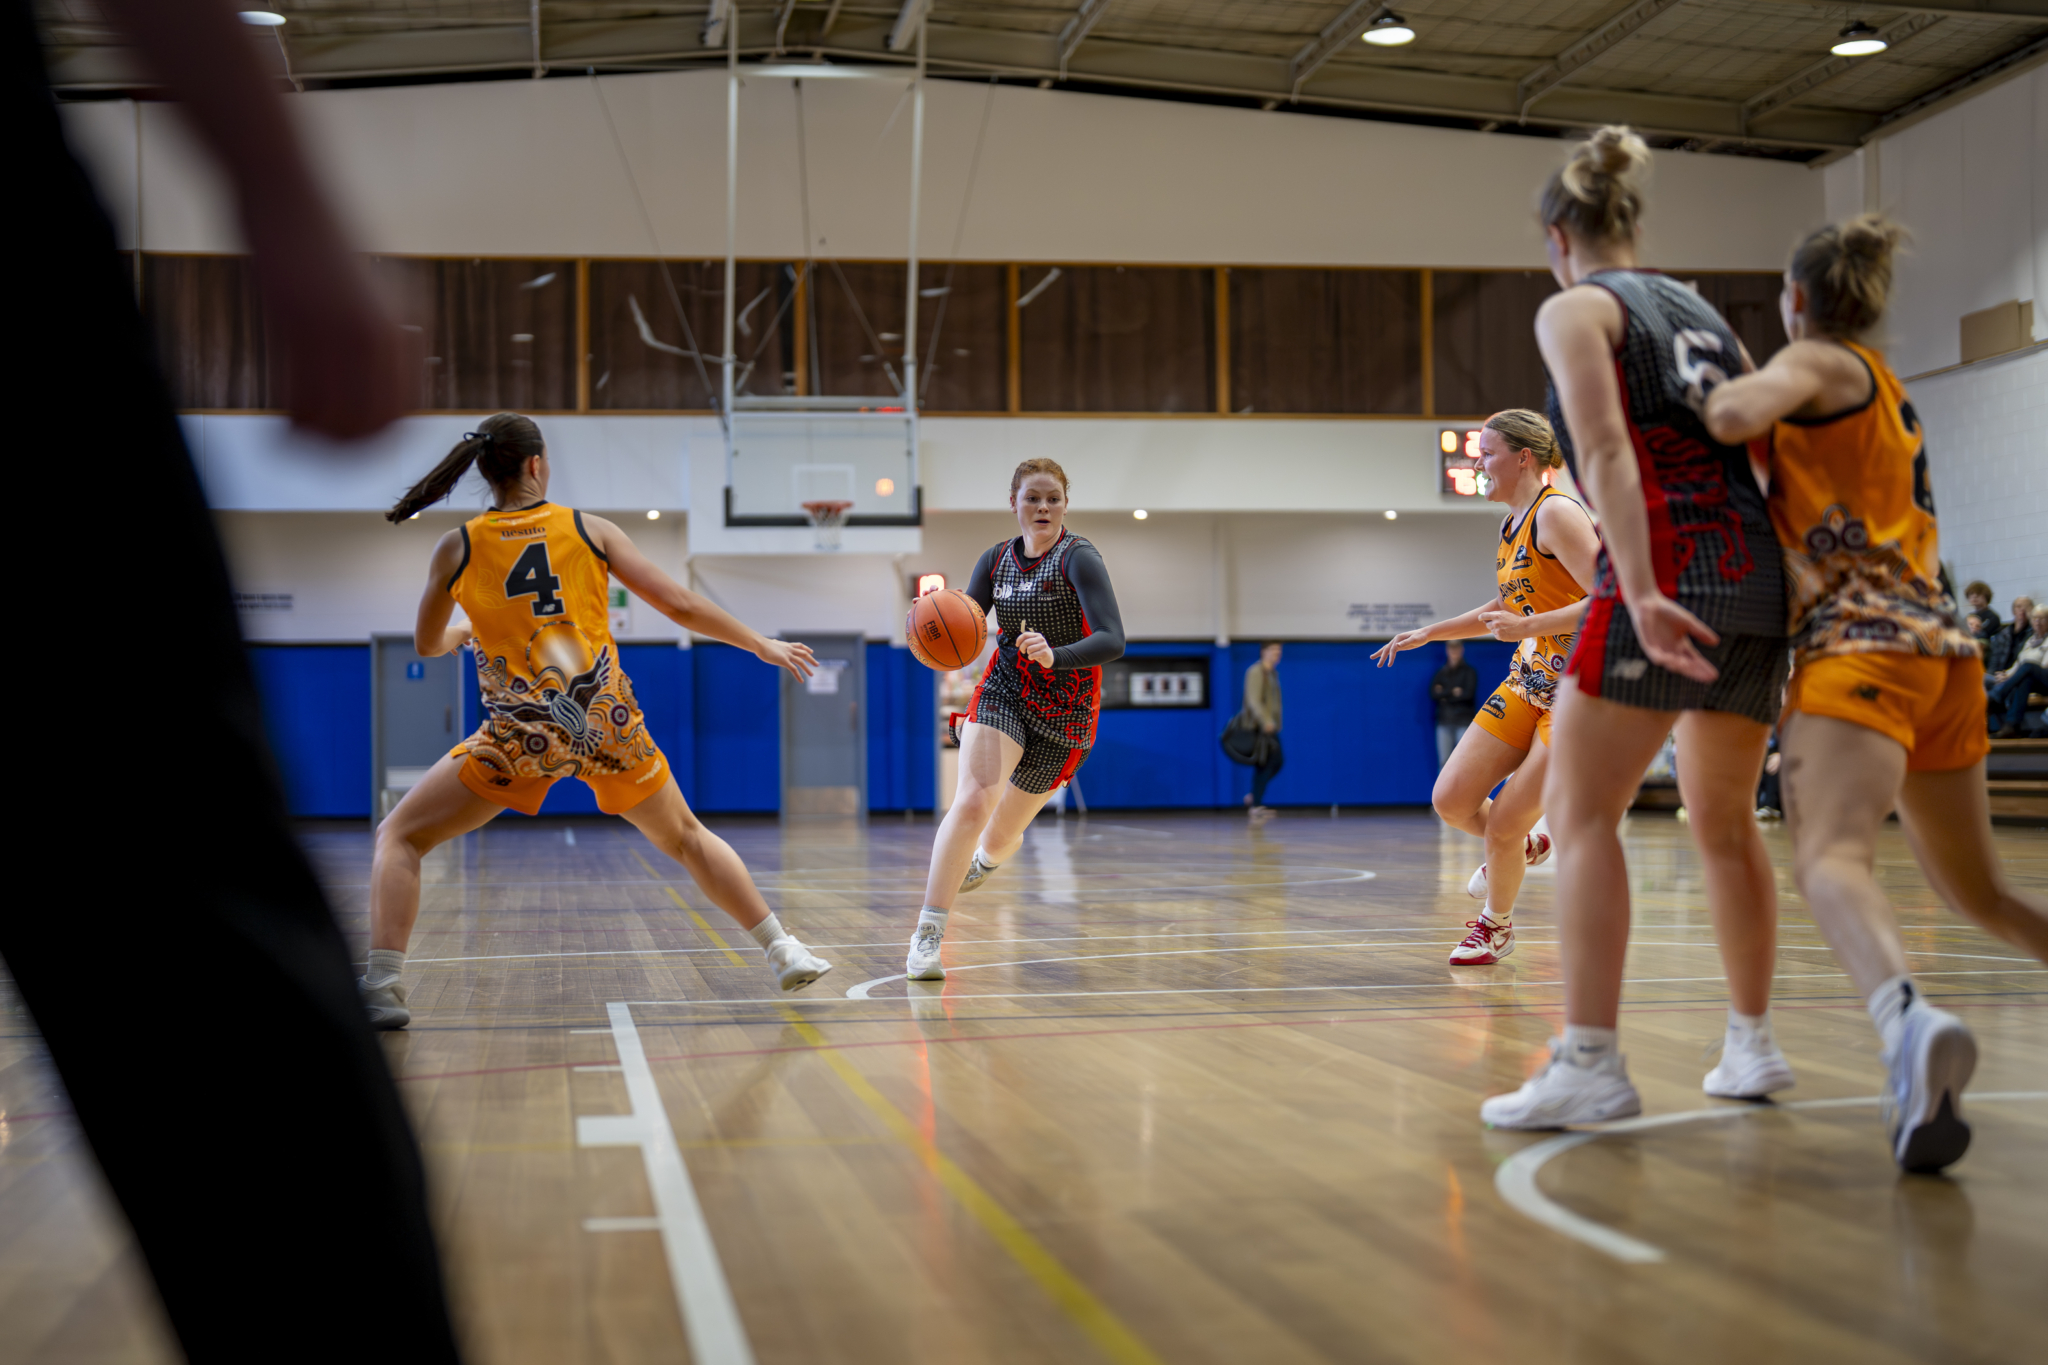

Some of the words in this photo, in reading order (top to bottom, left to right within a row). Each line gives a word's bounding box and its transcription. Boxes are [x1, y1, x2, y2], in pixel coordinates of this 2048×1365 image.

[501, 526, 546, 538] nesuto
[503, 541, 566, 618] 4
[927, 620, 941, 640] FIBA
